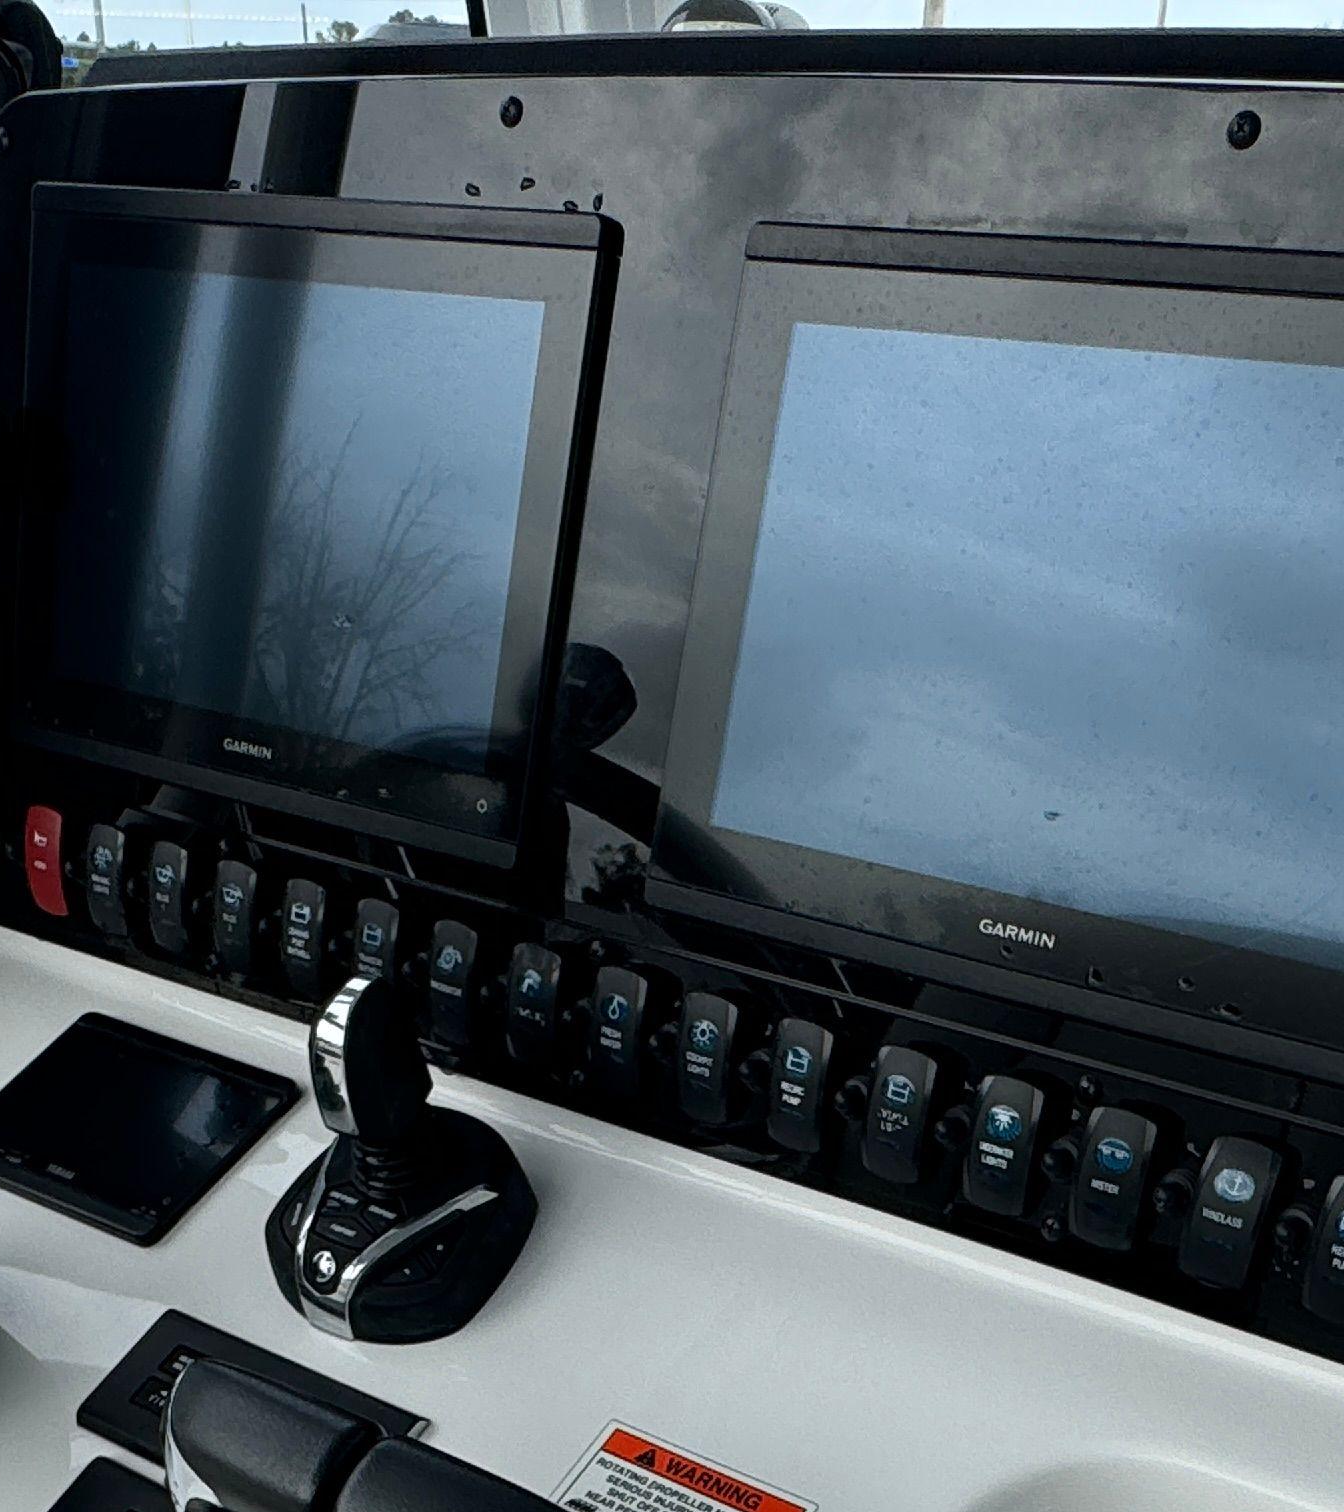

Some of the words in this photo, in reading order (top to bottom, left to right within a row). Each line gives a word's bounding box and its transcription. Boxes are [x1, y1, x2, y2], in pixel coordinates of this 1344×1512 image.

[222, 737, 272, 760] GARMIN
[978, 918, 1056, 950] GARMIN
[594, 1456, 650, 1485] ROTATING
[604, 1474, 654, 1500] SERIOUS
[604, 1487, 637, 1505] SHUT
[664, 1457, 764, 1511] WARNING
[583, 1490, 616, 1509] NEAR
